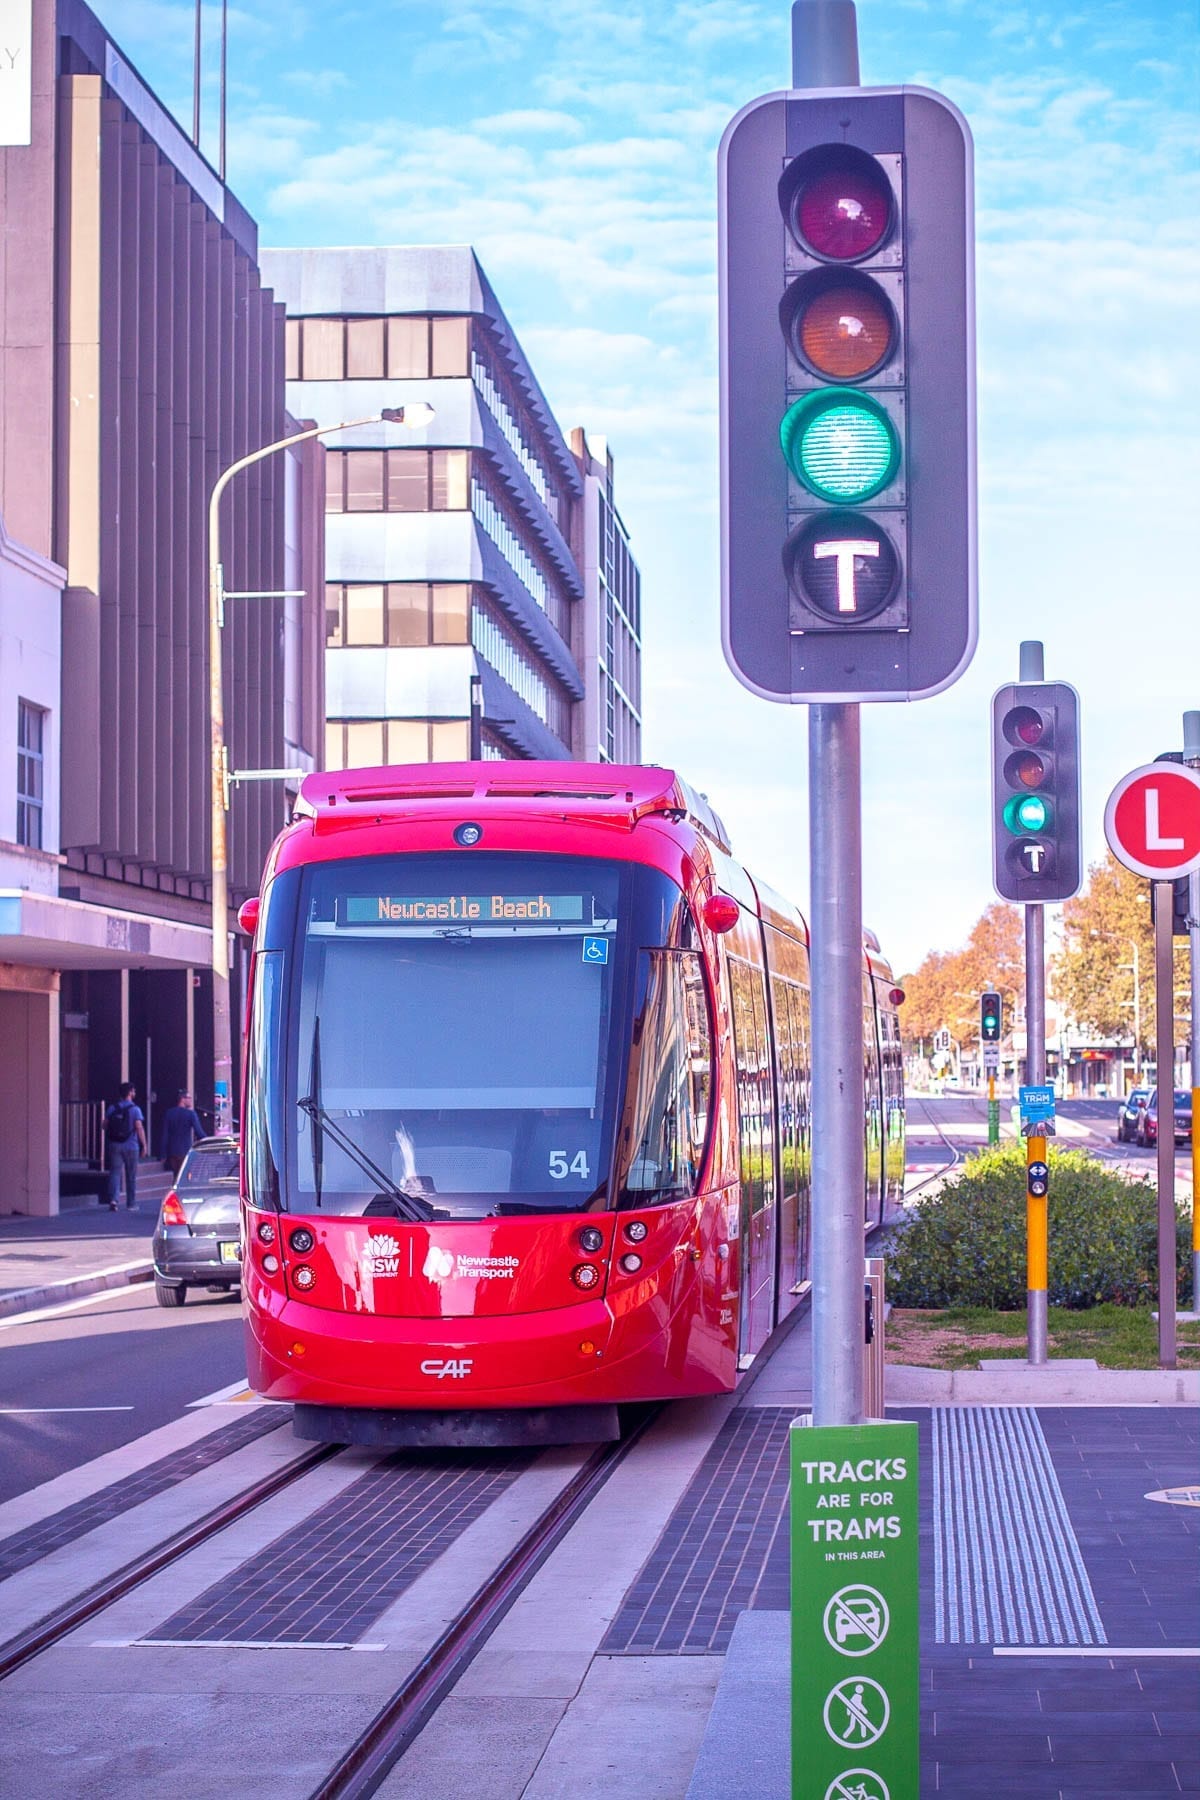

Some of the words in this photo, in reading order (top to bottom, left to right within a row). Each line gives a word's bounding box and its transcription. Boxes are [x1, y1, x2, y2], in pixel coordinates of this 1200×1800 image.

[0, 47, 21, 70] Y
[814, 540, 880, 612] T
[1145, 788, 1184, 850] L
[1023, 845, 1045, 873] T
[378, 897, 480, 919] Newcastle
[491, 895, 550, 918] Beach
[1024, 1094, 1050, 1103] TRAM
[549, 1150, 590, 1179] 54
[362, 1259, 400, 1273] NSW
[457, 1255, 519, 1267] Newcastle
[458, 1266, 514, 1279] Transport
[420, 1360, 473, 1379] CAF
[801, 1458, 907, 1484] TRACKS
[816, 1494, 851, 1508] ARE
[860, 1492, 894, 1506] FOR
[807, 1516, 901, 1542] TRAMS
[825, 1553, 835, 1561] IN
[837, 1552, 858, 1560] THIS
[860, 1550, 885, 1559] AREA
